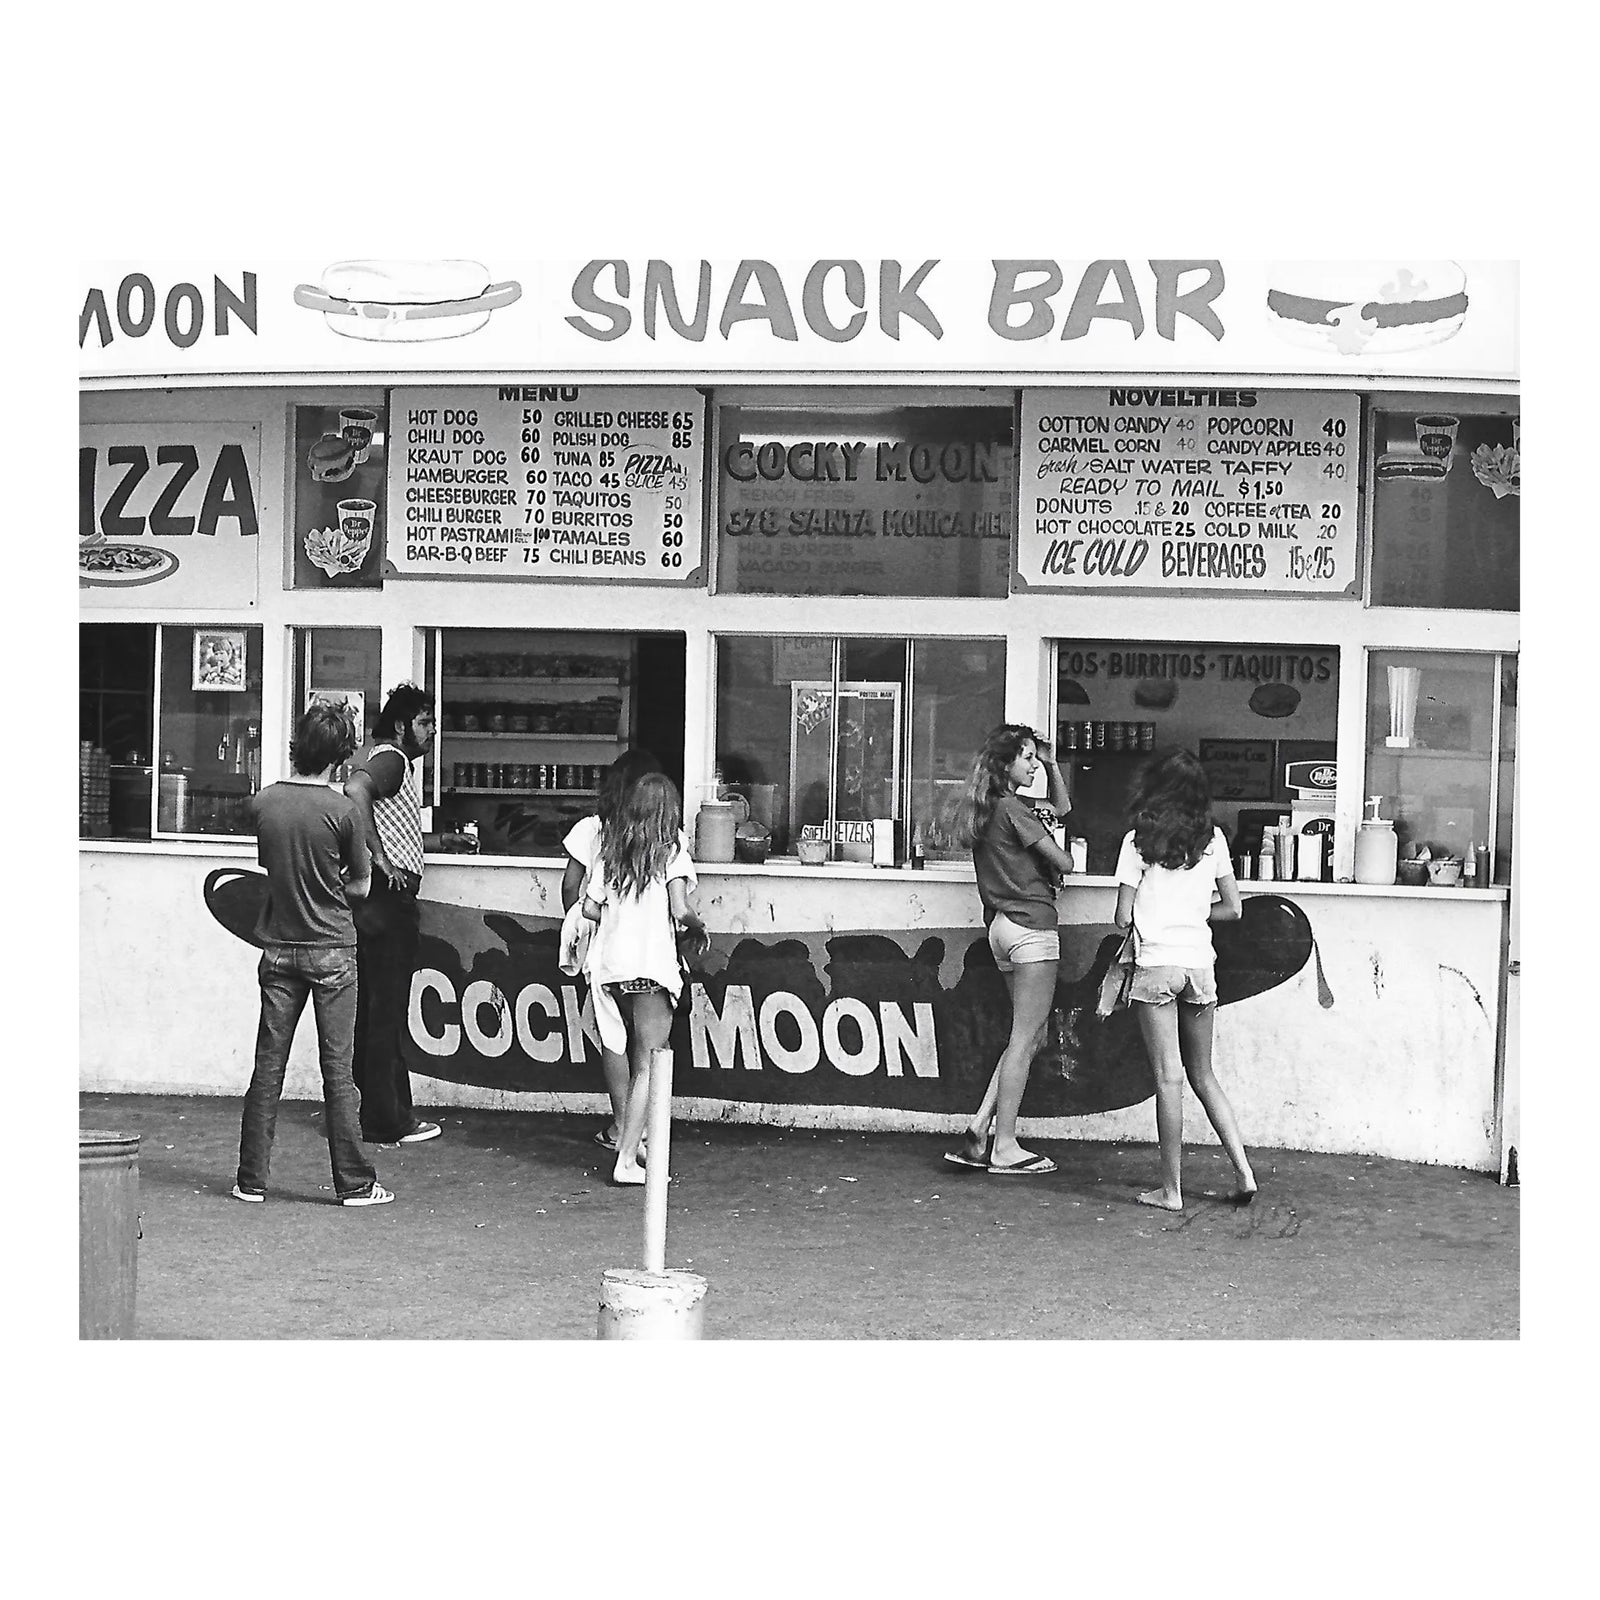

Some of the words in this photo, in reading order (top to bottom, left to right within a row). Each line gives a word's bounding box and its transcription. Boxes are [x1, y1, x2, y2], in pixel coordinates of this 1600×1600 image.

[564, 260, 943, 342] SNACK
[988, 260, 1225, 342] BAR
[498, 387, 579, 402] MENU
[1109, 390, 1258, 407] NOVELTIES
[408, 410, 437, 425] HOT
[444, 410, 478, 426] DOG
[522, 409, 542, 424] 50
[555, 411, 613, 428] GRILLED
[617, 411, 669, 428] CHEESE
[672, 412, 693, 430] 65
[1039, 416, 1109, 433] COTTON
[1114, 417, 1171, 433] CANDY
[1176, 418, 1194, 431] 40
[1208, 417, 1293, 437] POPCORN
[1322, 418, 1346, 438] 40
[408, 429, 445, 444] CHILI
[453, 430, 485, 445] DOG
[522, 428, 540, 444] 60
[553, 432, 596, 446] POLISH
[601, 433, 629, 446] DOG
[672, 432, 692, 448] 85
[1038, 437, 1109, 453] CARMEL
[1114, 439, 1160, 453] CORN
[1177, 437, 1195, 450] 40
[408, 449, 463, 464] KRAUT
[473, 450, 507, 465] DOG
[521, 447, 540, 463] 60
[1207, 440, 1263, 455] CANDY
[1266, 441, 1321, 457] APPLES
[1323, 441, 1345, 457] 40
[553, 452, 592, 467] TUNA
[600, 451, 615, 467] 85
[725, 442, 867, 482] COCKY
[875, 442, 999, 484] MOON
[407, 468, 509, 485] HAMBURGER
[526, 470, 547, 484] 60
[1090, 458, 1135, 474] SALT
[1141, 459, 1212, 474] WATER
[1221, 460, 1292, 475] TAFFY
[1323, 463, 1345, 478] 40
[553, 471, 592, 487] TACO
[600, 472, 620, 488] 45
[625, 473, 664, 488] SLICE
[1060, 478, 1128, 495] READY
[1136, 479, 1161, 495] TO
[1171, 479, 1224, 497] MAIL
[406, 488, 517, 505] CHEESEBURGER
[527, 489, 546, 505] 70
[553, 491, 631, 508] TAQUITOS
[665, 496, 682, 510] 50
[1037, 498, 1112, 514] DONUTS
[1172, 501, 1189, 515] 20
[1205, 501, 1266, 518] COFFEE
[1282, 504, 1311, 519] TEA
[1322, 504, 1341, 519] 20
[406, 507, 442, 523] CHILI
[447, 508, 501, 524] BURGER
[525, 509, 544, 523] 70
[552, 511, 633, 527] BURRITOS
[664, 514, 683, 528] 50
[788, 509, 876, 536] SANTA
[882, 510, 969, 538] MONICA
[407, 526, 436, 541] HOT
[441, 527, 513, 543] PASTRAMI
[1036, 519, 1071, 534] HOT
[1078, 519, 1172, 536] CHOCOLATE
[1175, 522, 1196, 537] 25
[1205, 522, 1250, 538] COLD
[1259, 523, 1298, 539] MILK
[552, 530, 630, 546] TAMALES
[662, 531, 683, 547] 60
[407, 545, 472, 564] BAR-B-Q
[476, 548, 508, 562] BEEF
[523, 548, 540, 563] 75
[550, 549, 587, 564] CHILI
[592, 550, 646, 566] BEANS
[661, 552, 682, 567] 60
[1041, 539, 1084, 575] ICE
[1083, 538, 1149, 576] COLD
[1162, 540, 1266, 579] BEVERAGES
[1108, 653, 1206, 680] BURRITOS
[1217, 654, 1331, 683] TAQUITOS
[1317, 821, 1331, 832] Dr
[690, 982, 940, 1078] MOON
